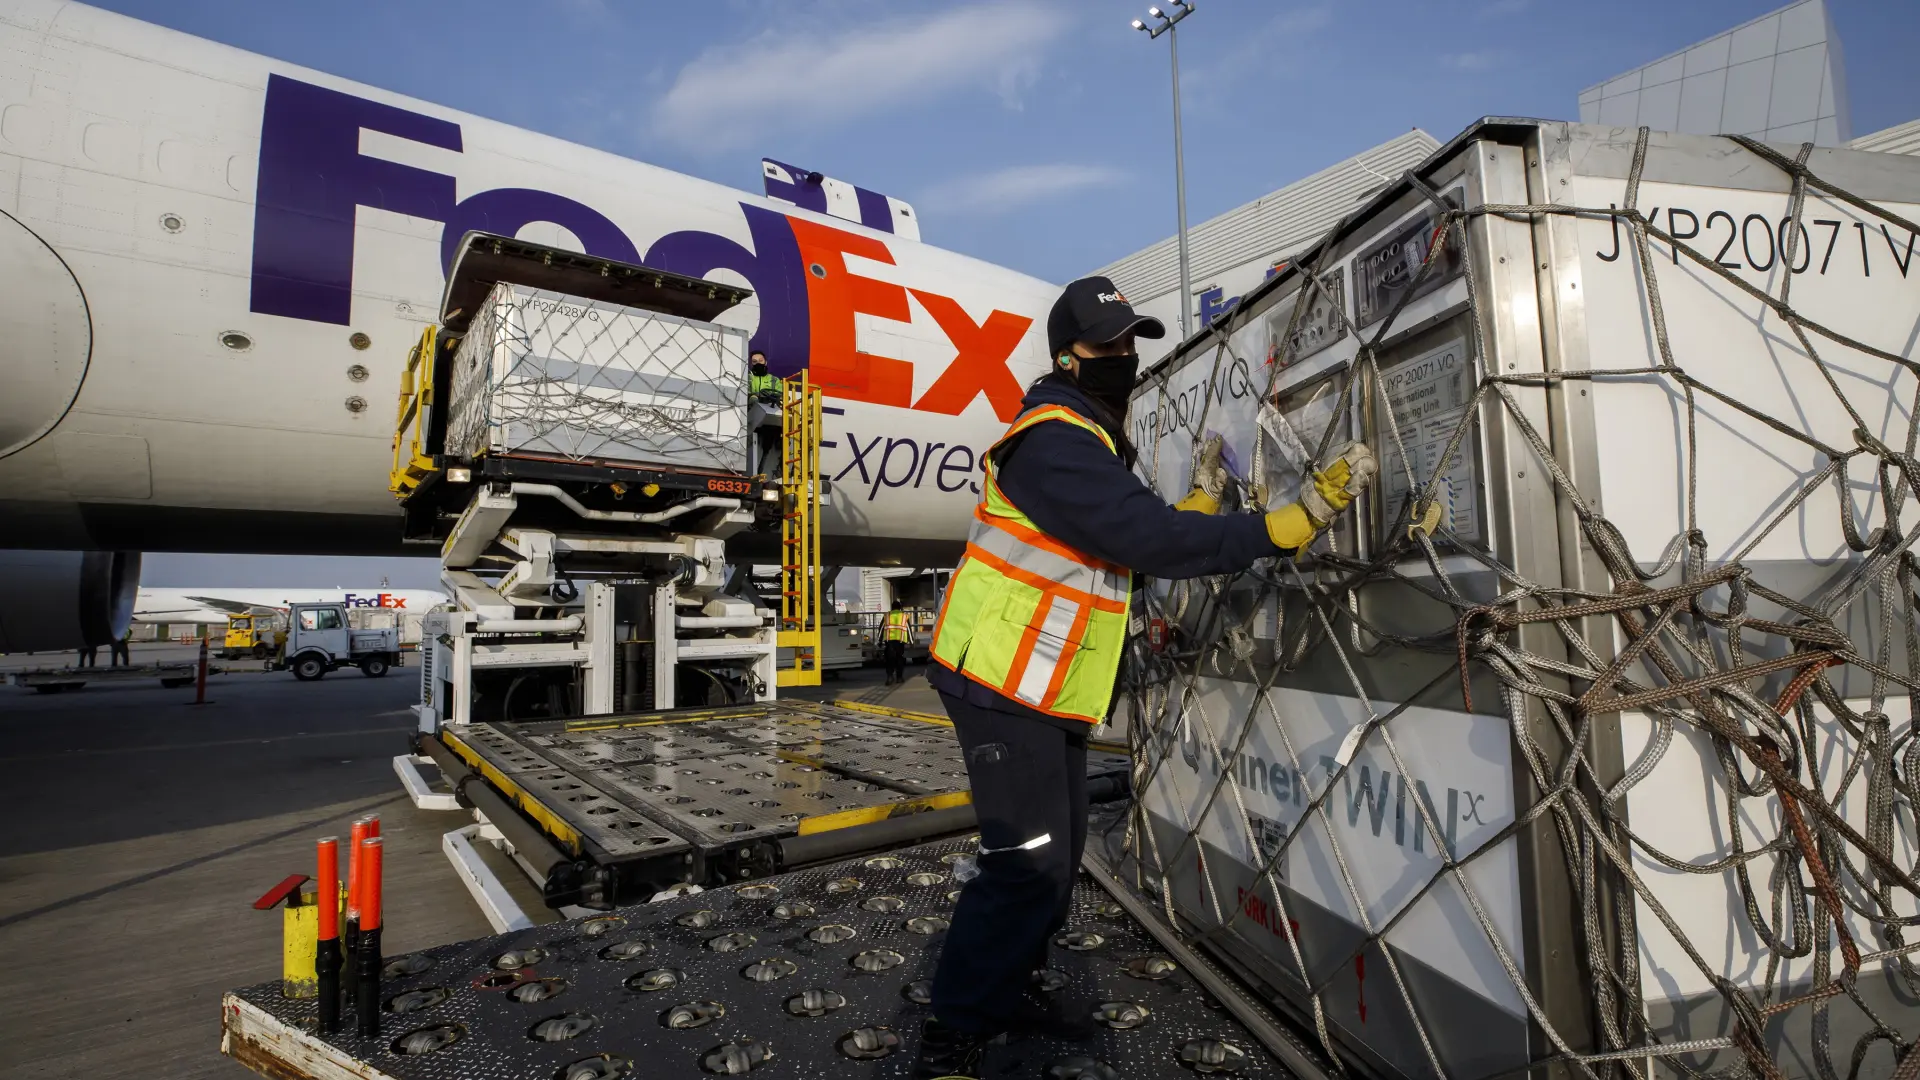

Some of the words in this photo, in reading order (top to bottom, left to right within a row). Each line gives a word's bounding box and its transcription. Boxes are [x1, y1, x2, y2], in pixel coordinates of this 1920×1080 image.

[1385, 374, 1403, 394] JYP
[1405, 361, 1434, 386] 20071
[1437, 353, 1455, 373] VQ
[707, 479, 752, 494] 66337
[344, 593, 407, 609] FedEx
